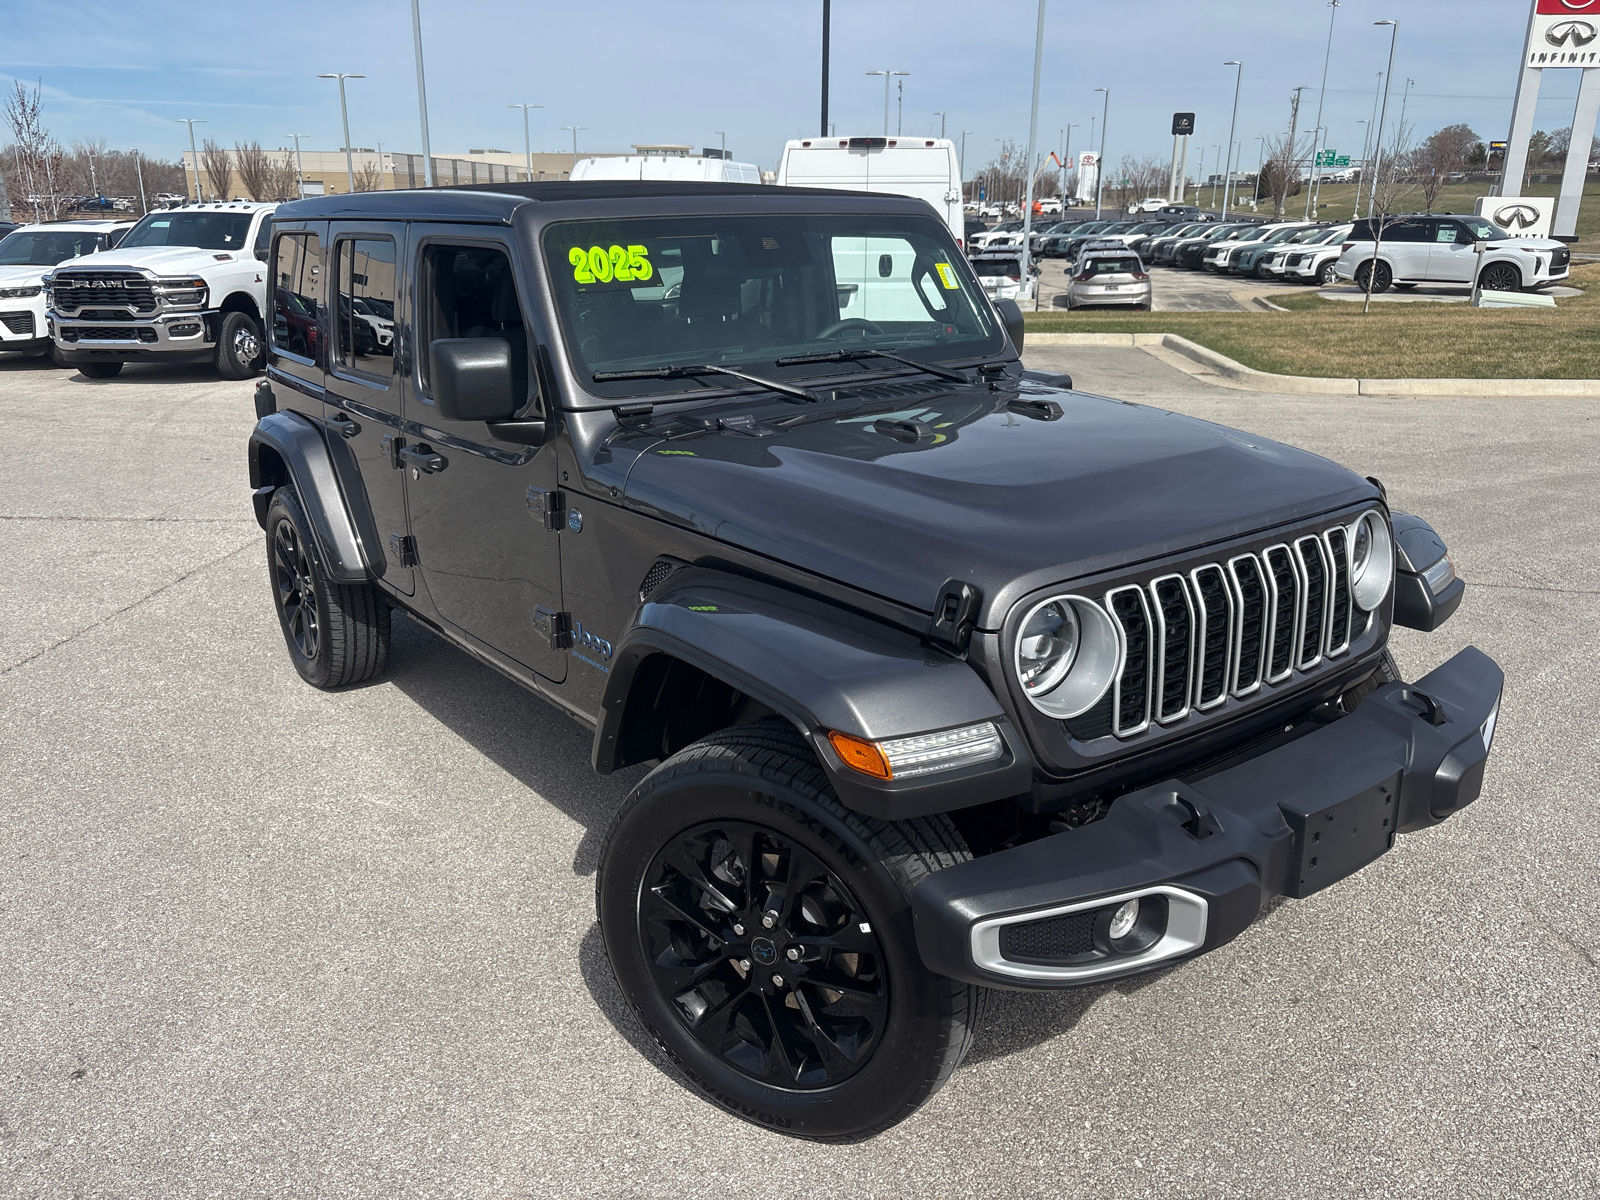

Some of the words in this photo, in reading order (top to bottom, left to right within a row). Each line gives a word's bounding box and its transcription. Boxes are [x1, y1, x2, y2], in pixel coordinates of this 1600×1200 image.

[1530, 52, 1600, 63] INFINIT
[74, 280, 123, 288] RAM
[569, 245, 653, 284] 2025
[570, 621, 612, 662] Jeep
[755, 791, 859, 865] NEXEN
[685, 1067, 793, 1128] ROADIAN
